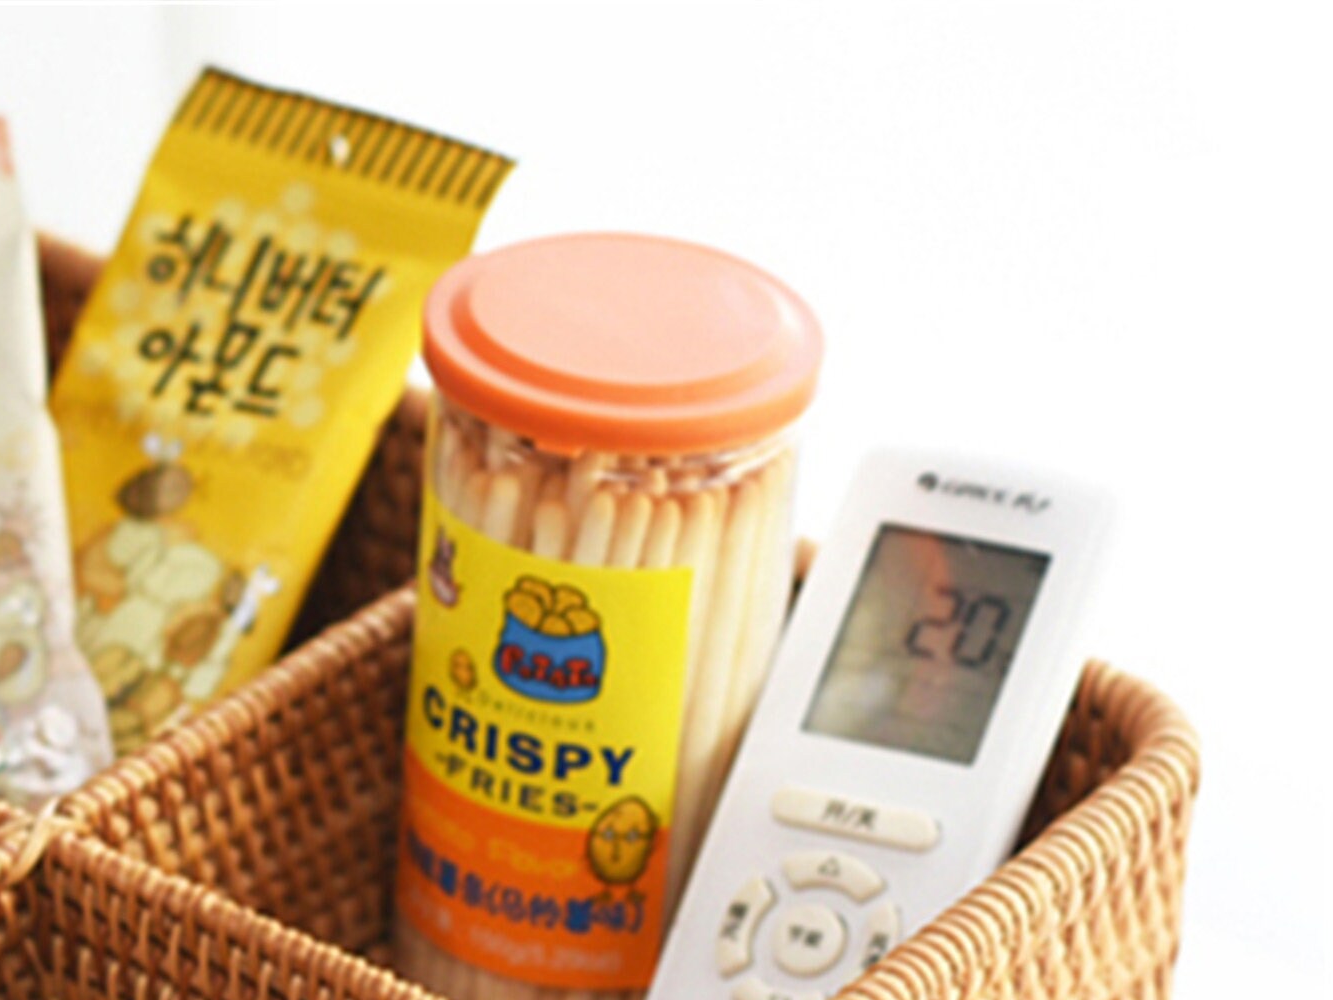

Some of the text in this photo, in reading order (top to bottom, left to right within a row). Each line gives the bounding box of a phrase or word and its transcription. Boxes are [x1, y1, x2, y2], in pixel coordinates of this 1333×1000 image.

[147, 214, 386, 342] 허니버터
[139, 318, 302, 418] 아몬드
[904, 586, 1012, 671] 20
[423, 685, 635, 786] CRISPY
